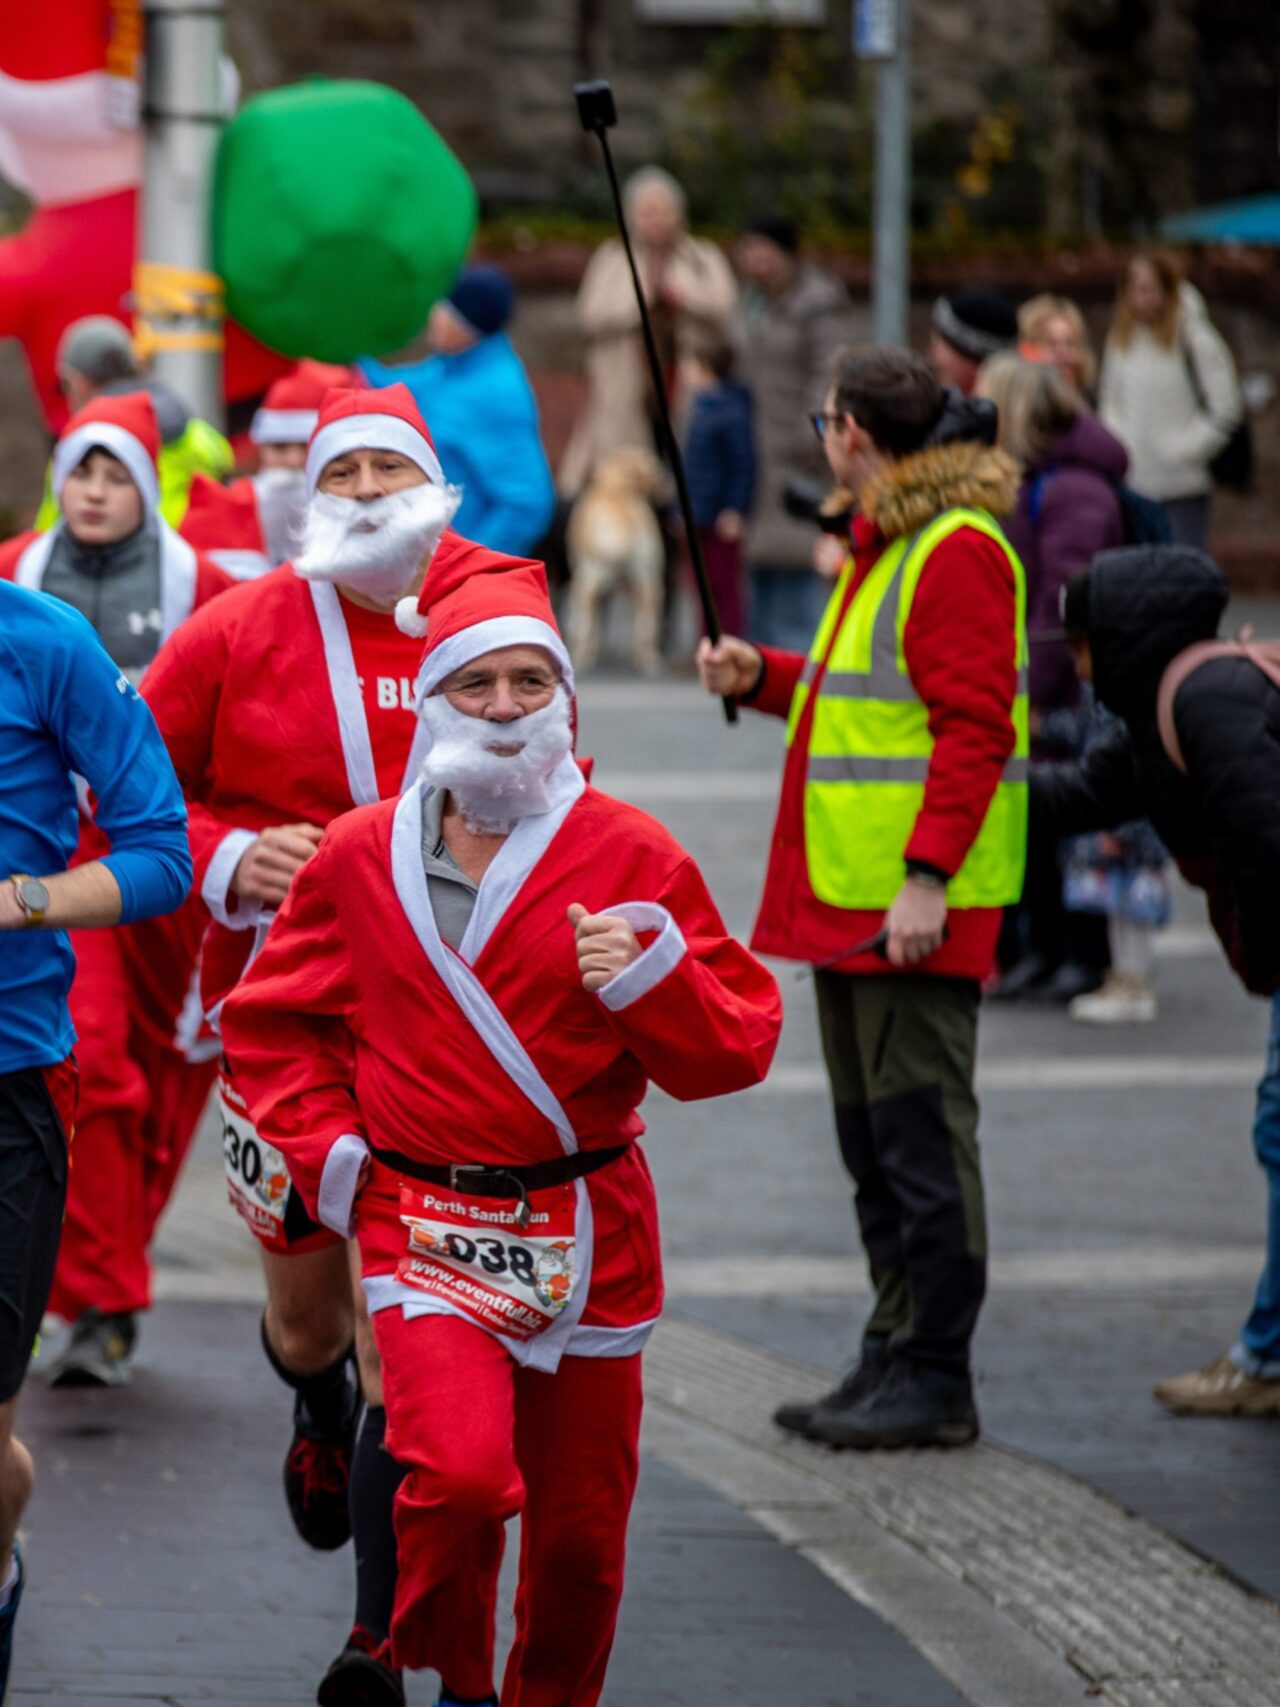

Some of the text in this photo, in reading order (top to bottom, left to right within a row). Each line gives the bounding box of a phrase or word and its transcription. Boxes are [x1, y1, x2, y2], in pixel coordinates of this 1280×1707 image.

[423, 1194, 467, 1216] Perth
[468, 1206, 516, 1224] Santa
[444, 1232, 538, 1288] 038
[410, 1259, 543, 1329] www.eventfull.biz
